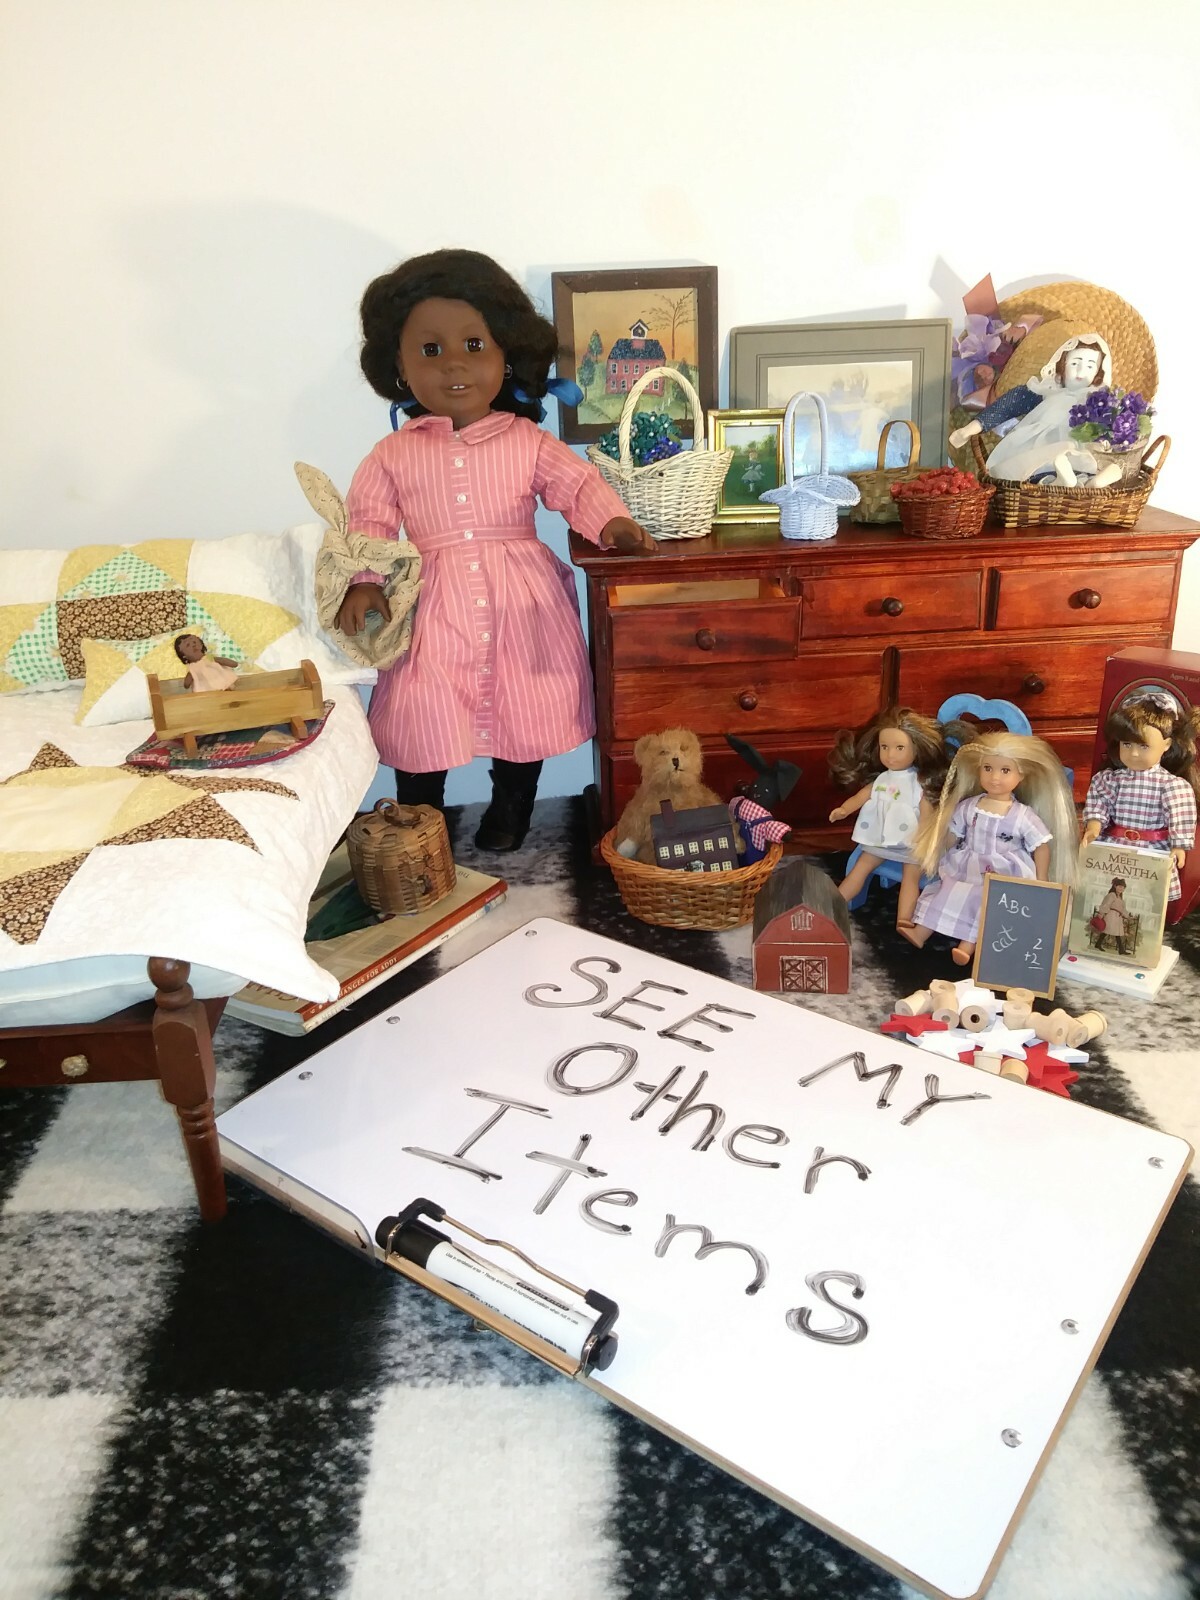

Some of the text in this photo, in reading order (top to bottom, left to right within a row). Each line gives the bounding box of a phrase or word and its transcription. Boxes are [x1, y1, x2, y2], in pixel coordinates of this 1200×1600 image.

[1085, 857, 1159, 880] SAMANTHA
[1108, 853, 1139, 866] MEET
[998, 893, 1031, 918] ABC
[992, 924, 1018, 952] cat
[1032, 938, 1043, 950] 2
[338, 956, 399, 999] HANGES FOR ADDY
[522, 956, 992, 1125] SEE MY
[545, 1042, 873, 1194] Other
